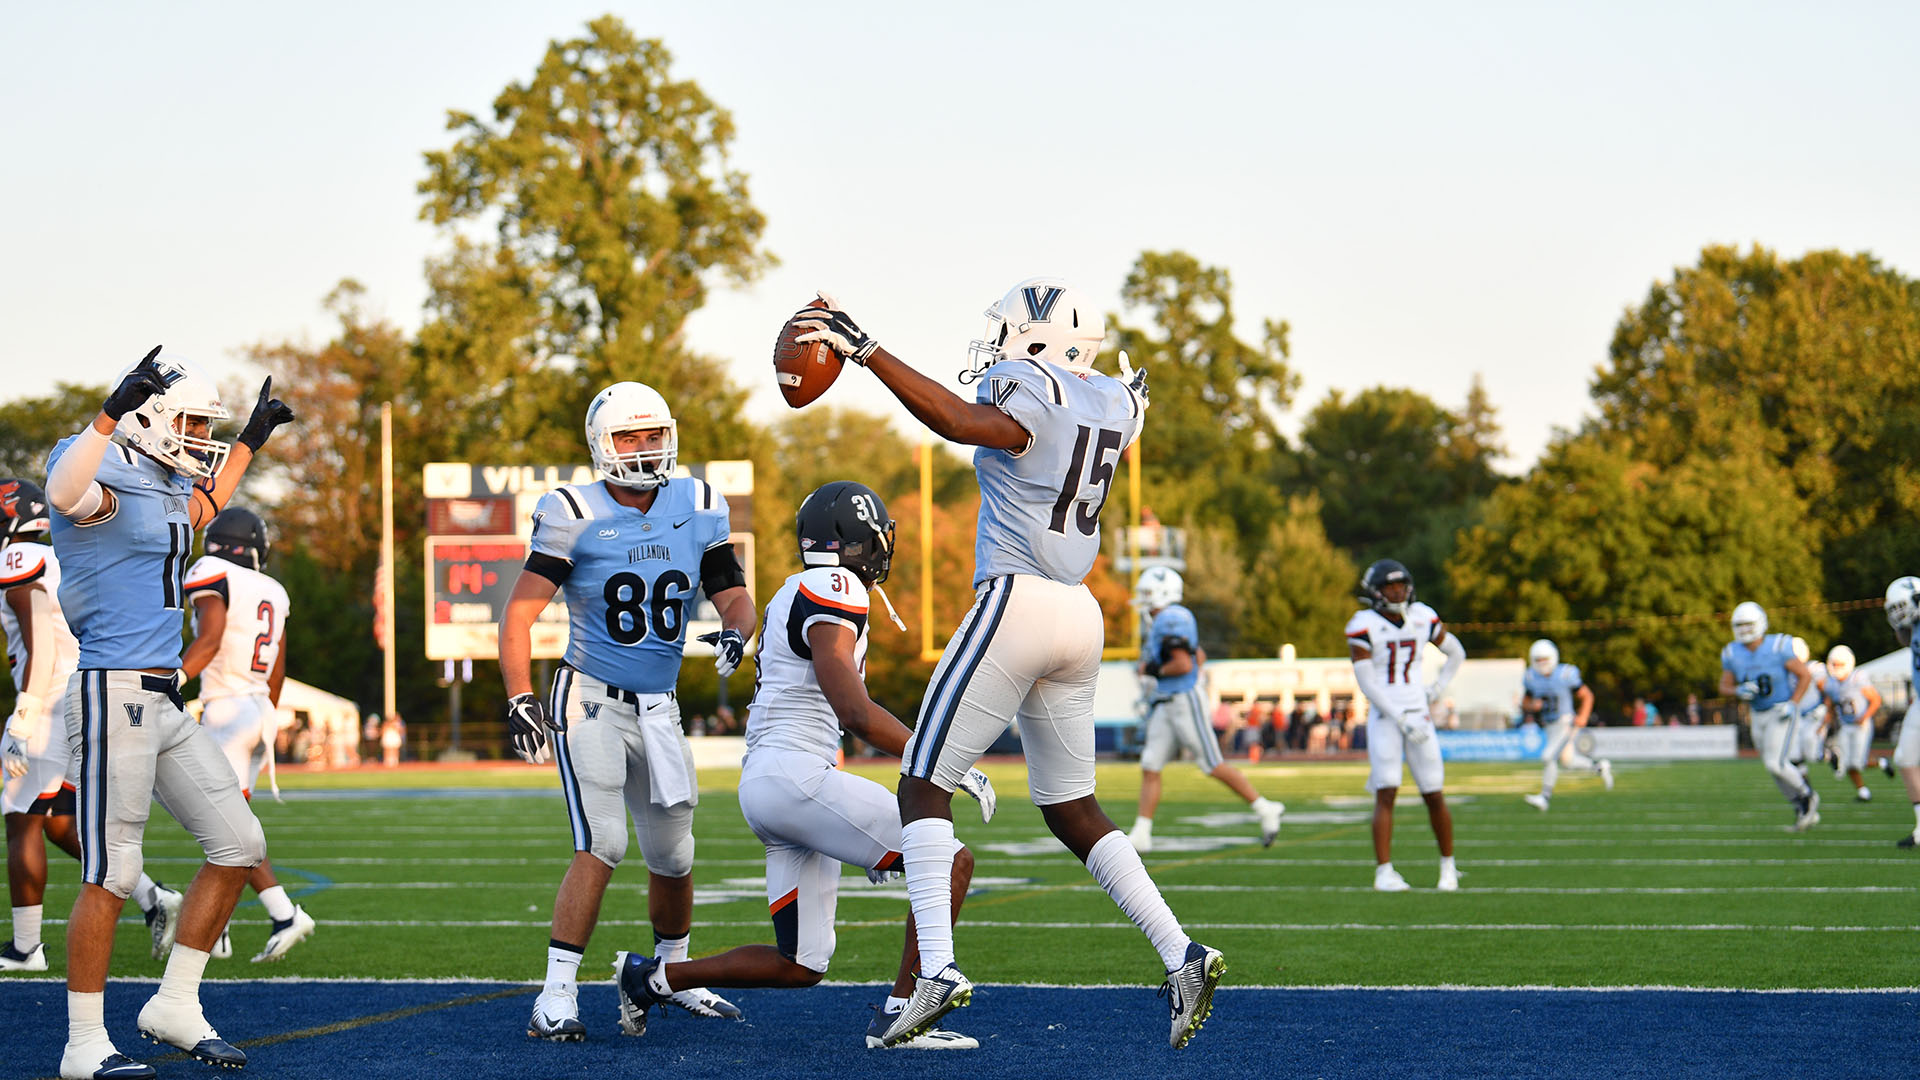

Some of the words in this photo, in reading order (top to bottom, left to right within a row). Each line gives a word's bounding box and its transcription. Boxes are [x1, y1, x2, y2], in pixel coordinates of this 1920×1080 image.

[1021, 286, 1066, 323] V
[791, 375, 798, 385] 9
[990, 377, 1022, 409] V
[1048, 424, 1123, 539] 15
[851, 494, 878, 521] 31
[598, 529, 616, 537] CAA
[6, 551, 23, 570] 42
[162, 521, 192, 612] 11
[627, 543, 672, 565] VILLANOVA
[831, 573, 849, 595] 31
[603, 569, 692, 646] 86
[251, 600, 275, 673] 2
[1387, 639, 1417, 685] 17
[123, 702, 145, 728] V
[580, 701, 602, 720] V
